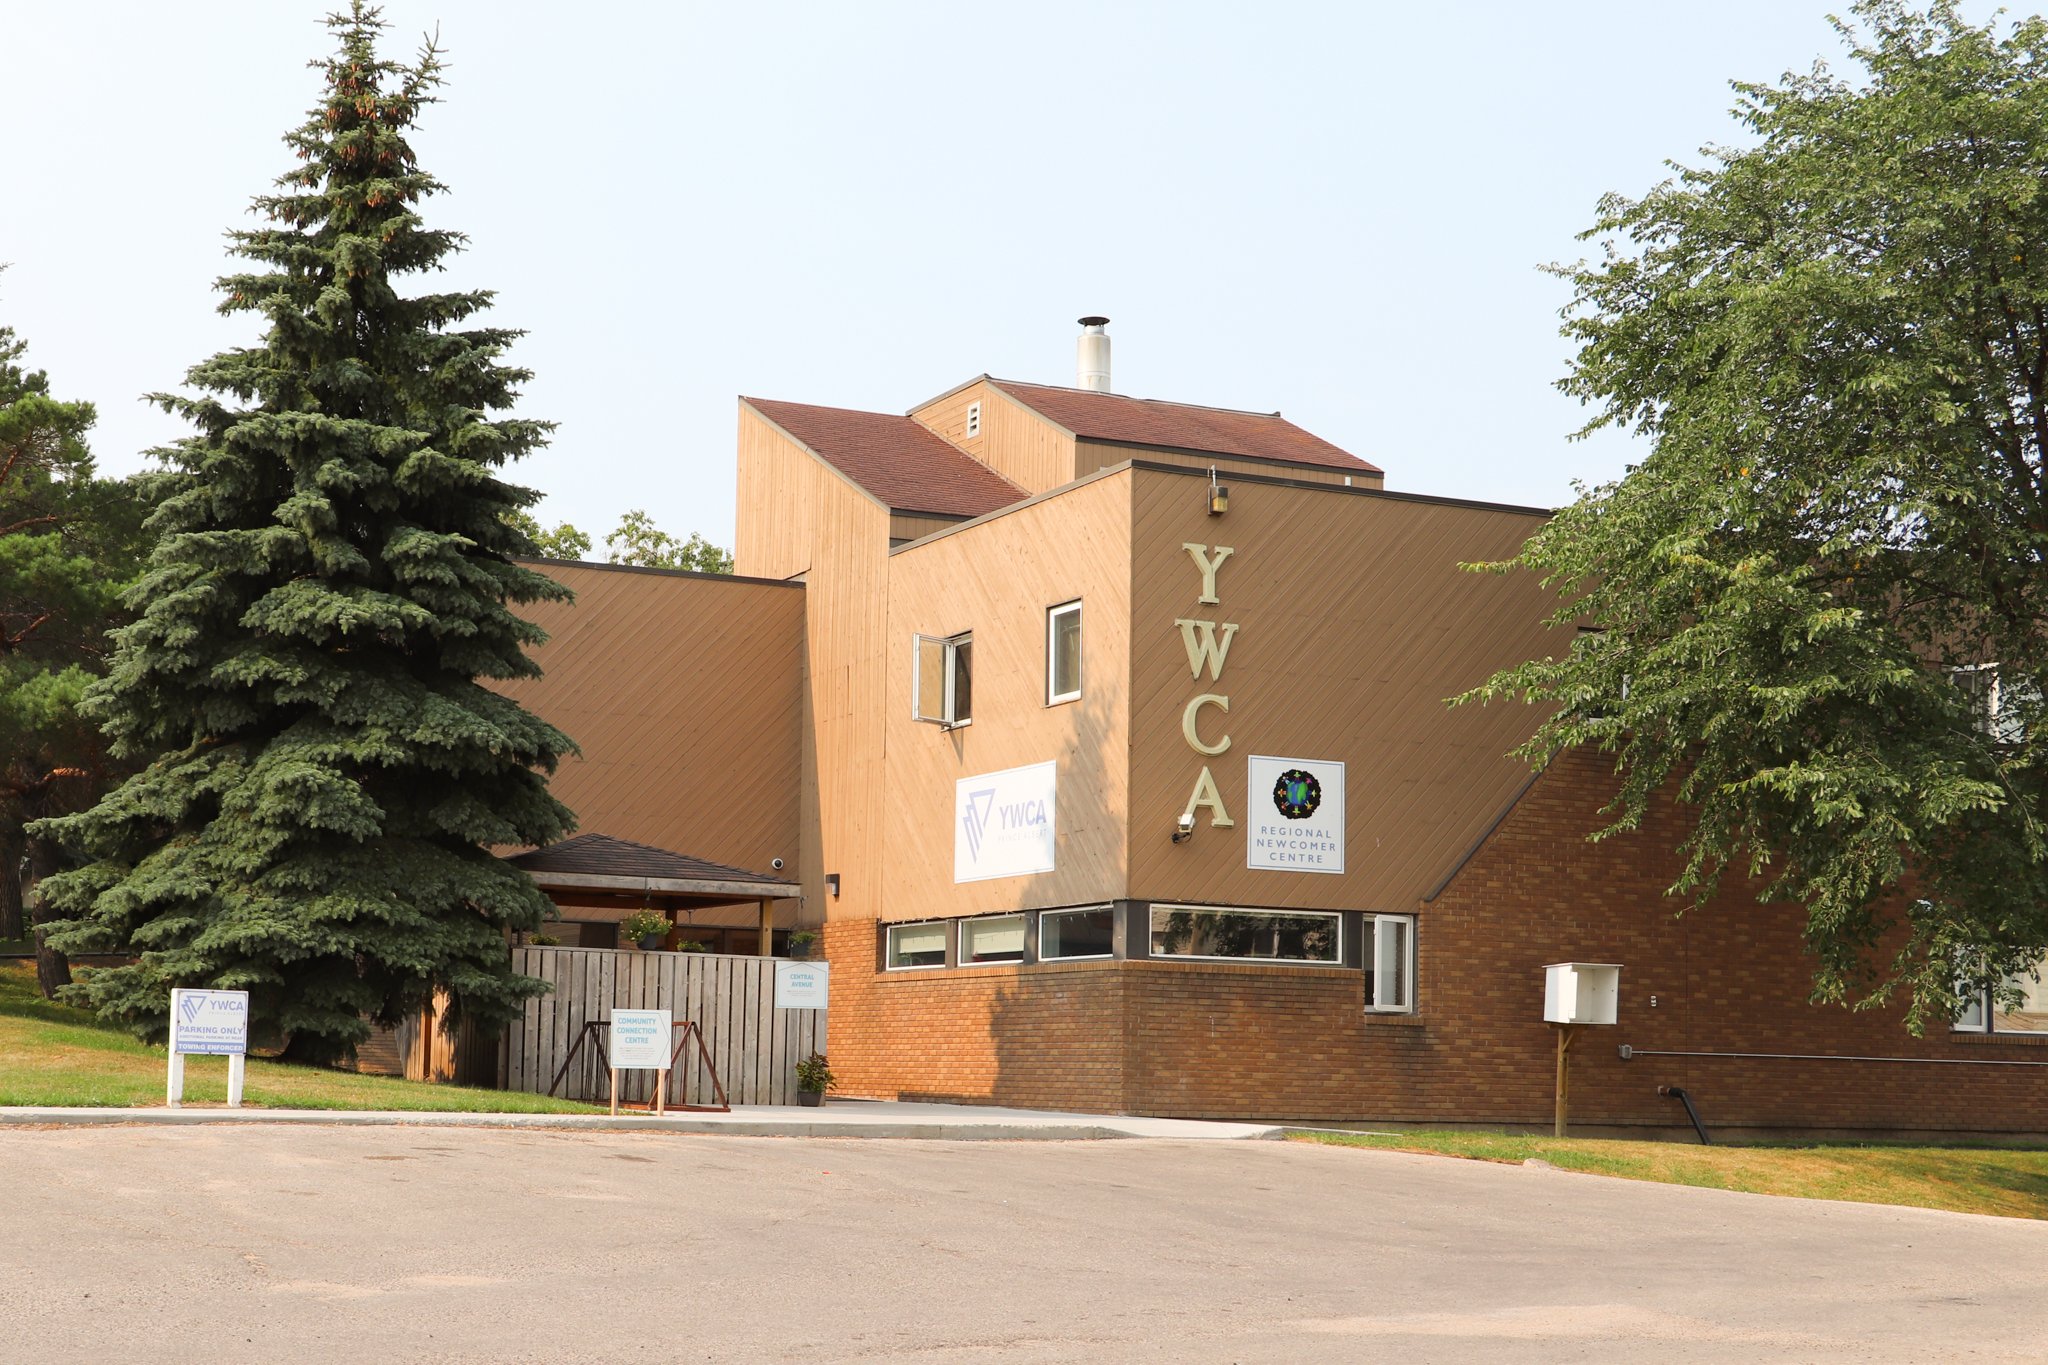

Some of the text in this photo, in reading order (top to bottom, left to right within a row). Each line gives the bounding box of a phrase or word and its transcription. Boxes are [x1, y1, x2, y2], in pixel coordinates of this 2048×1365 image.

[1174, 542, 1239, 829] YWCA
[999, 799, 1047, 831] YWCA
[1261, 825, 1331, 839] REGIONAL
[1256, 838, 1336, 852] NEWCOMER
[1269, 852, 1323, 864] CENTRE
[209, 1000, 244, 1011] YWCA
[617, 1017, 657, 1025] COMMUNITY
[179, 1025, 243, 1035] PARKING ONLY
[624, 1036, 649, 1044] CENTRE
